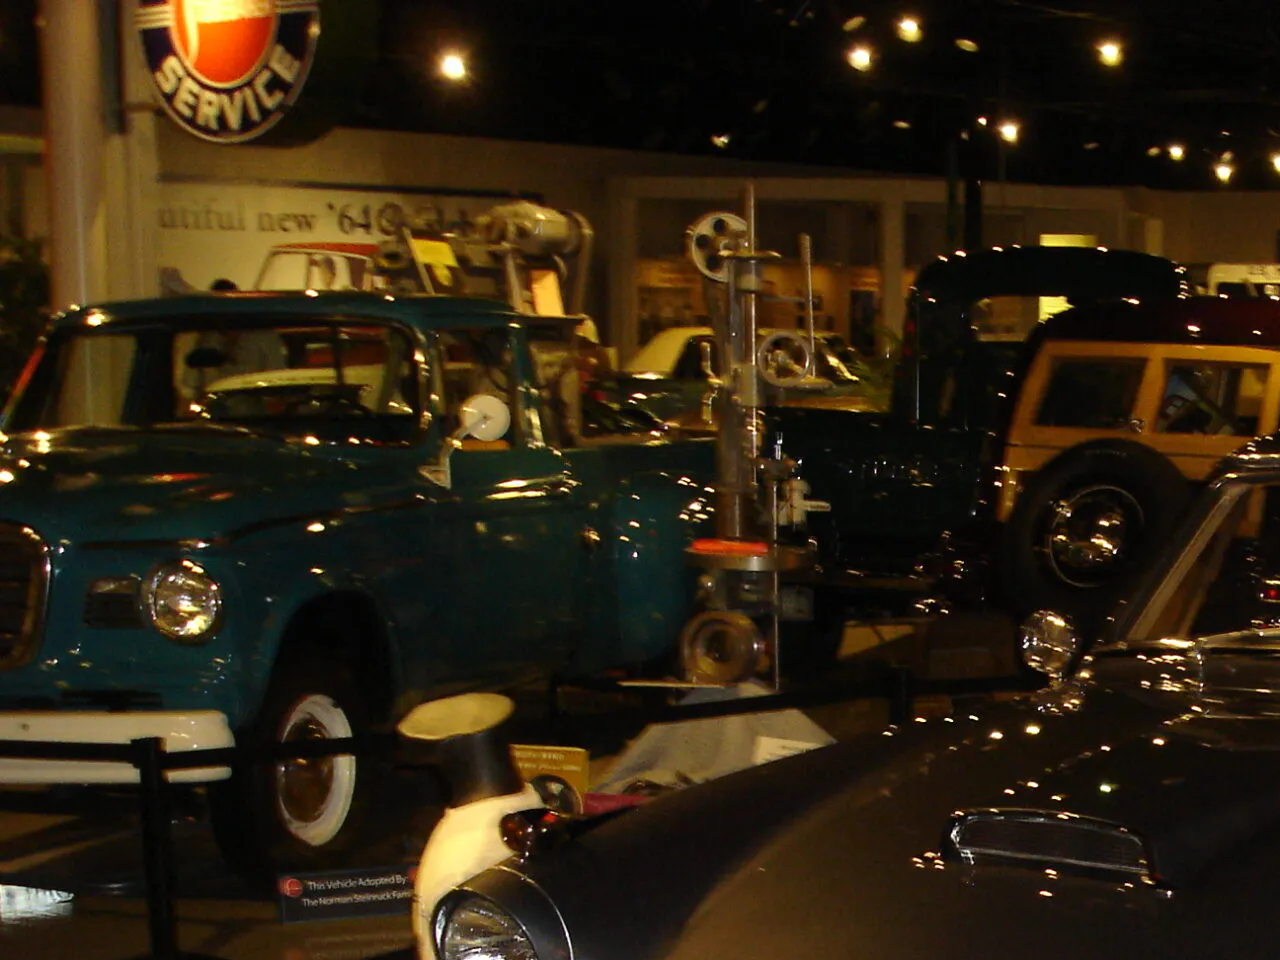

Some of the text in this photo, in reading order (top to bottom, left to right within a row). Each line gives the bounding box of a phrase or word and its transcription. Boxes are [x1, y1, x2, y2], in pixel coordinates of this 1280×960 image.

[155, 44, 301, 131] SERVICE
[256, 210, 317, 234] new
[308, 881, 325, 891] This
[326, 878, 358, 890] Vehicle
[358, 874, 396, 888] Adopted
[303, 897, 318, 908] The
[318, 895, 354, 907] Norman
